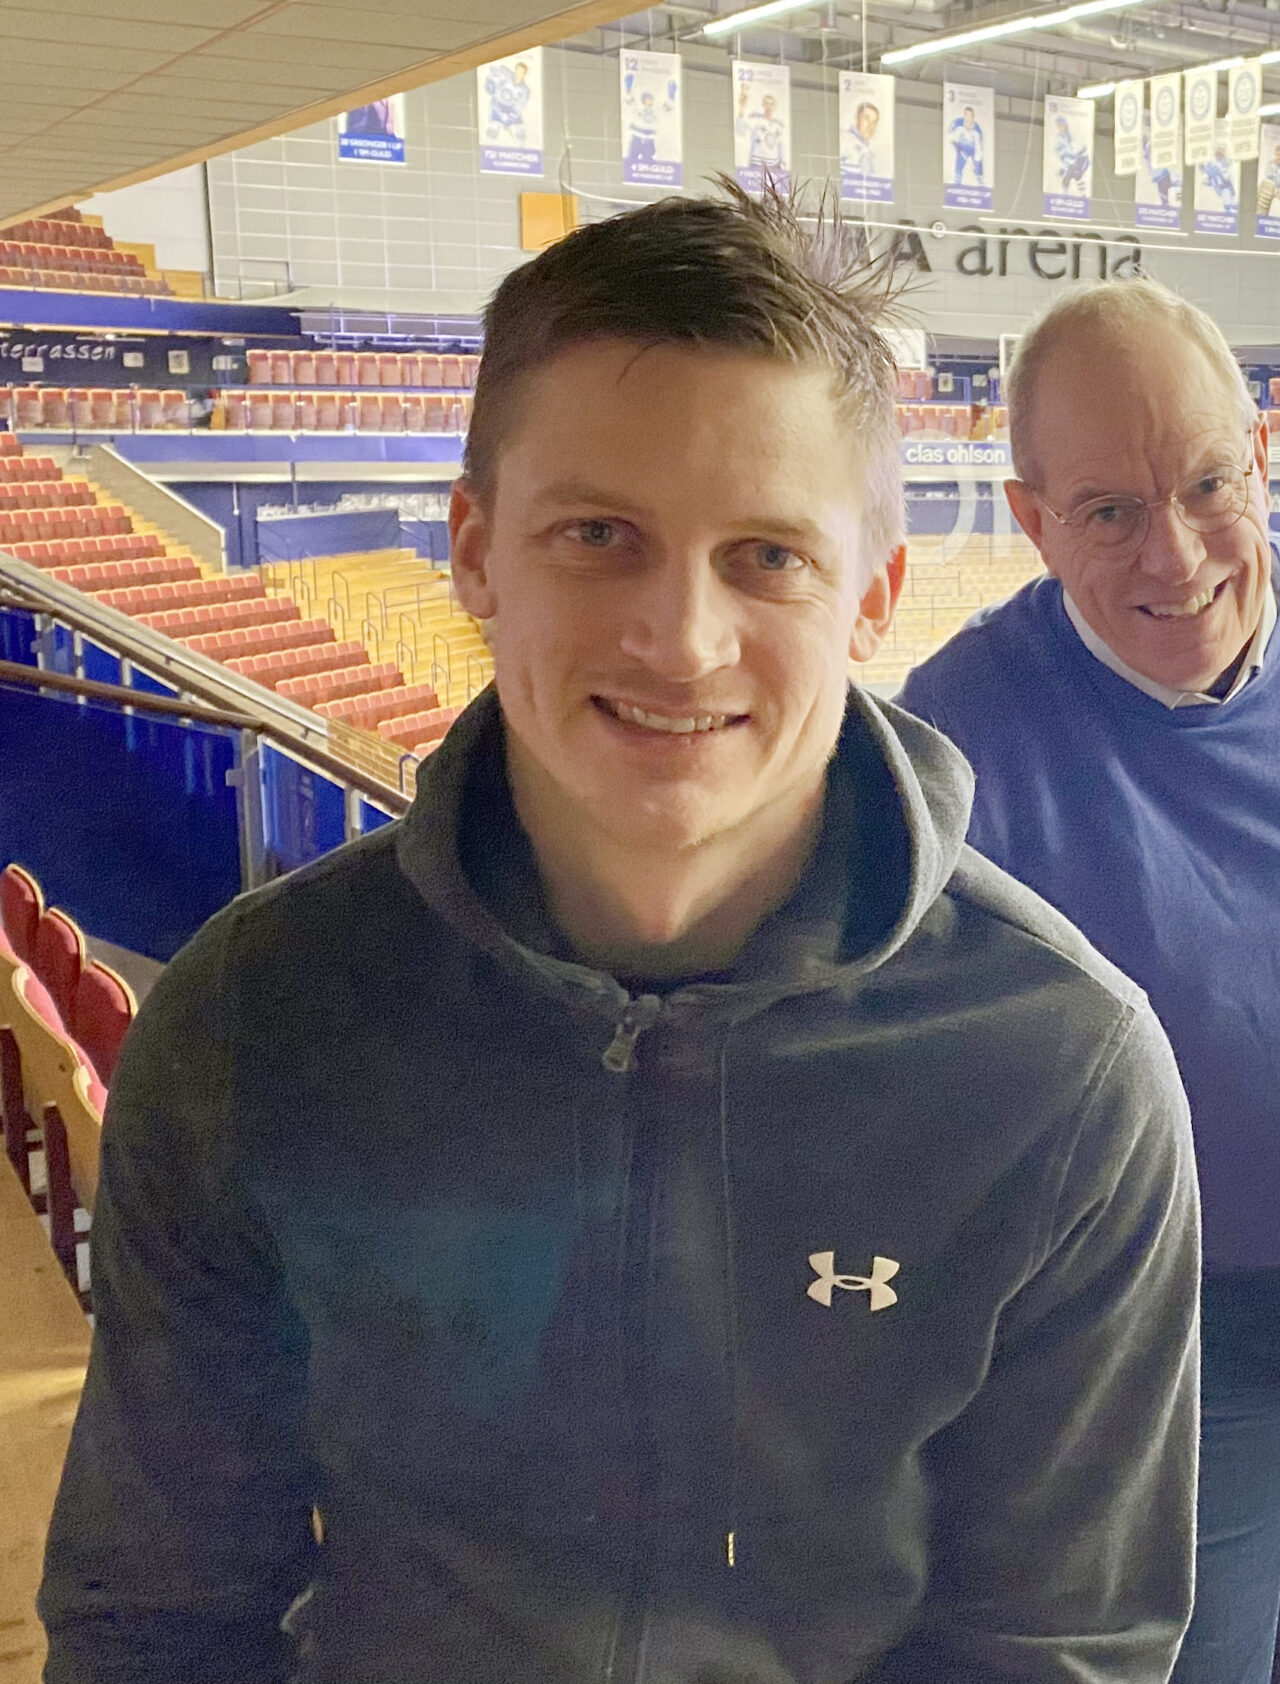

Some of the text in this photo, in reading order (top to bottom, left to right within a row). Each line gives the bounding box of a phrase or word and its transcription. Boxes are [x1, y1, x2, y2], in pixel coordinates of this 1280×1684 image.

[955, 224, 1145, 281] arena
[905, 444, 1006, 464] clas ohlson
